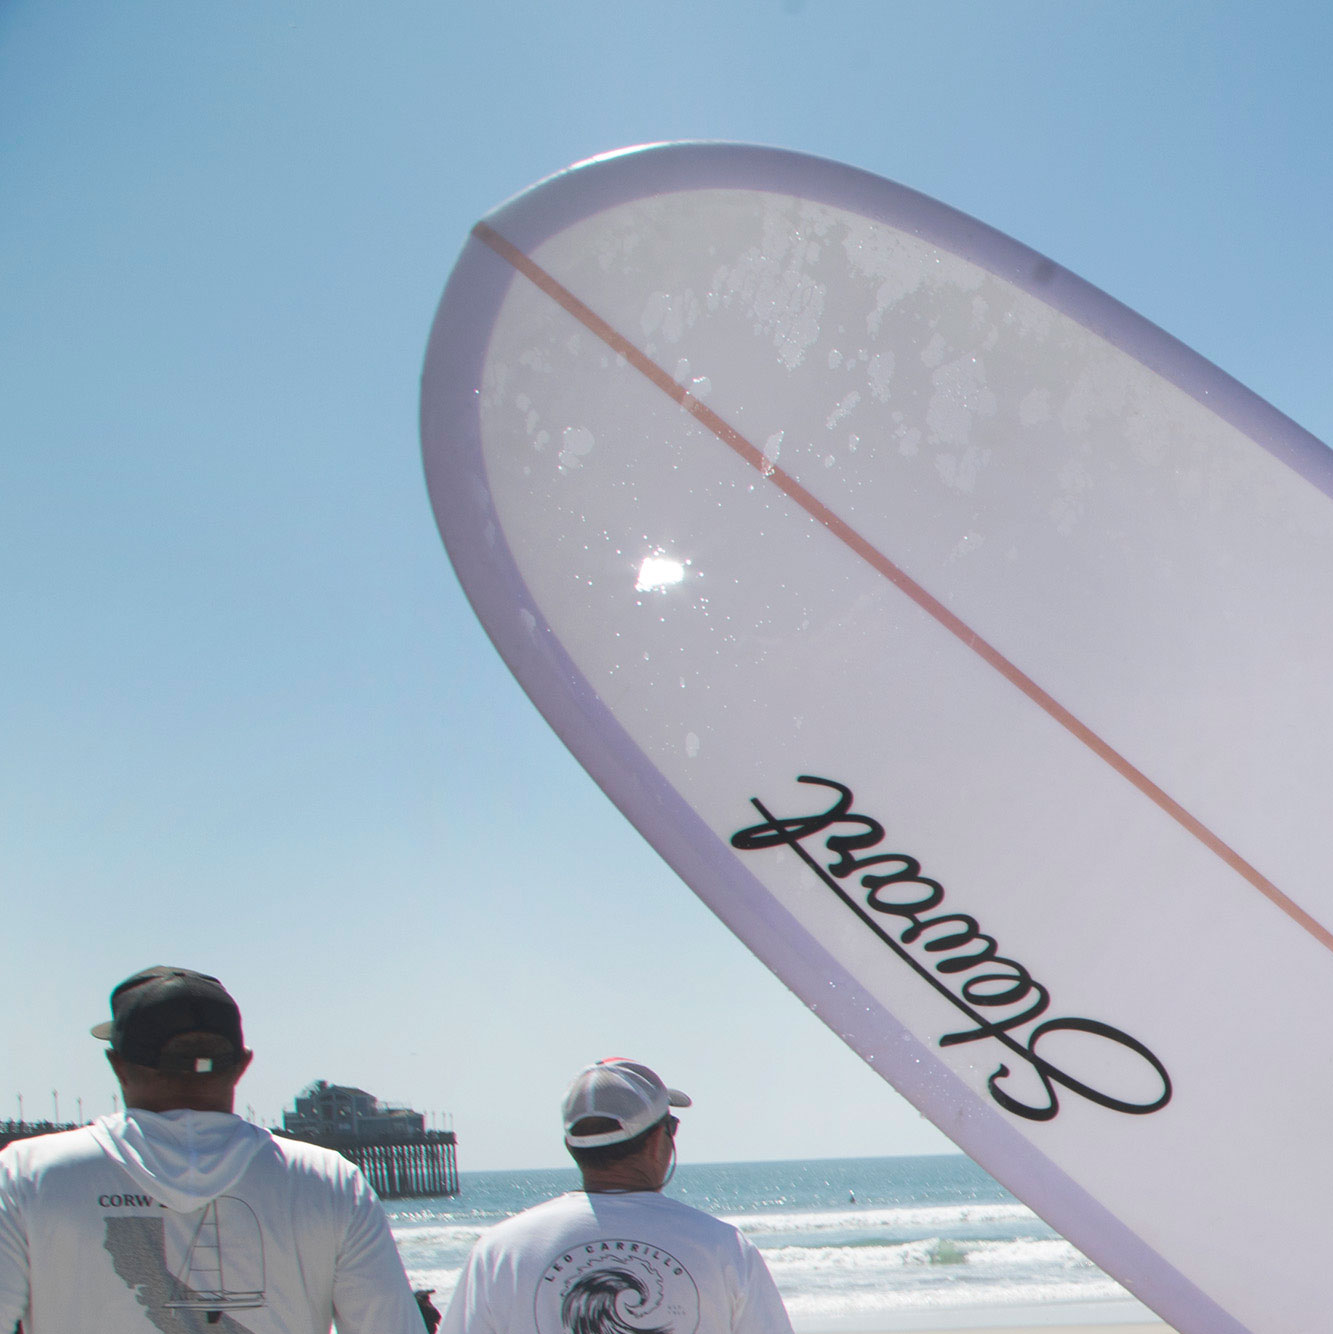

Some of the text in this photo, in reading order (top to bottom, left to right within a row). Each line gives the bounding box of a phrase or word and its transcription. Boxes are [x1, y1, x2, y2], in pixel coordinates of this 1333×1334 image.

[730, 775, 1172, 1122] Stewart
[544, 1242, 684, 1283] LEO CARRILLO
